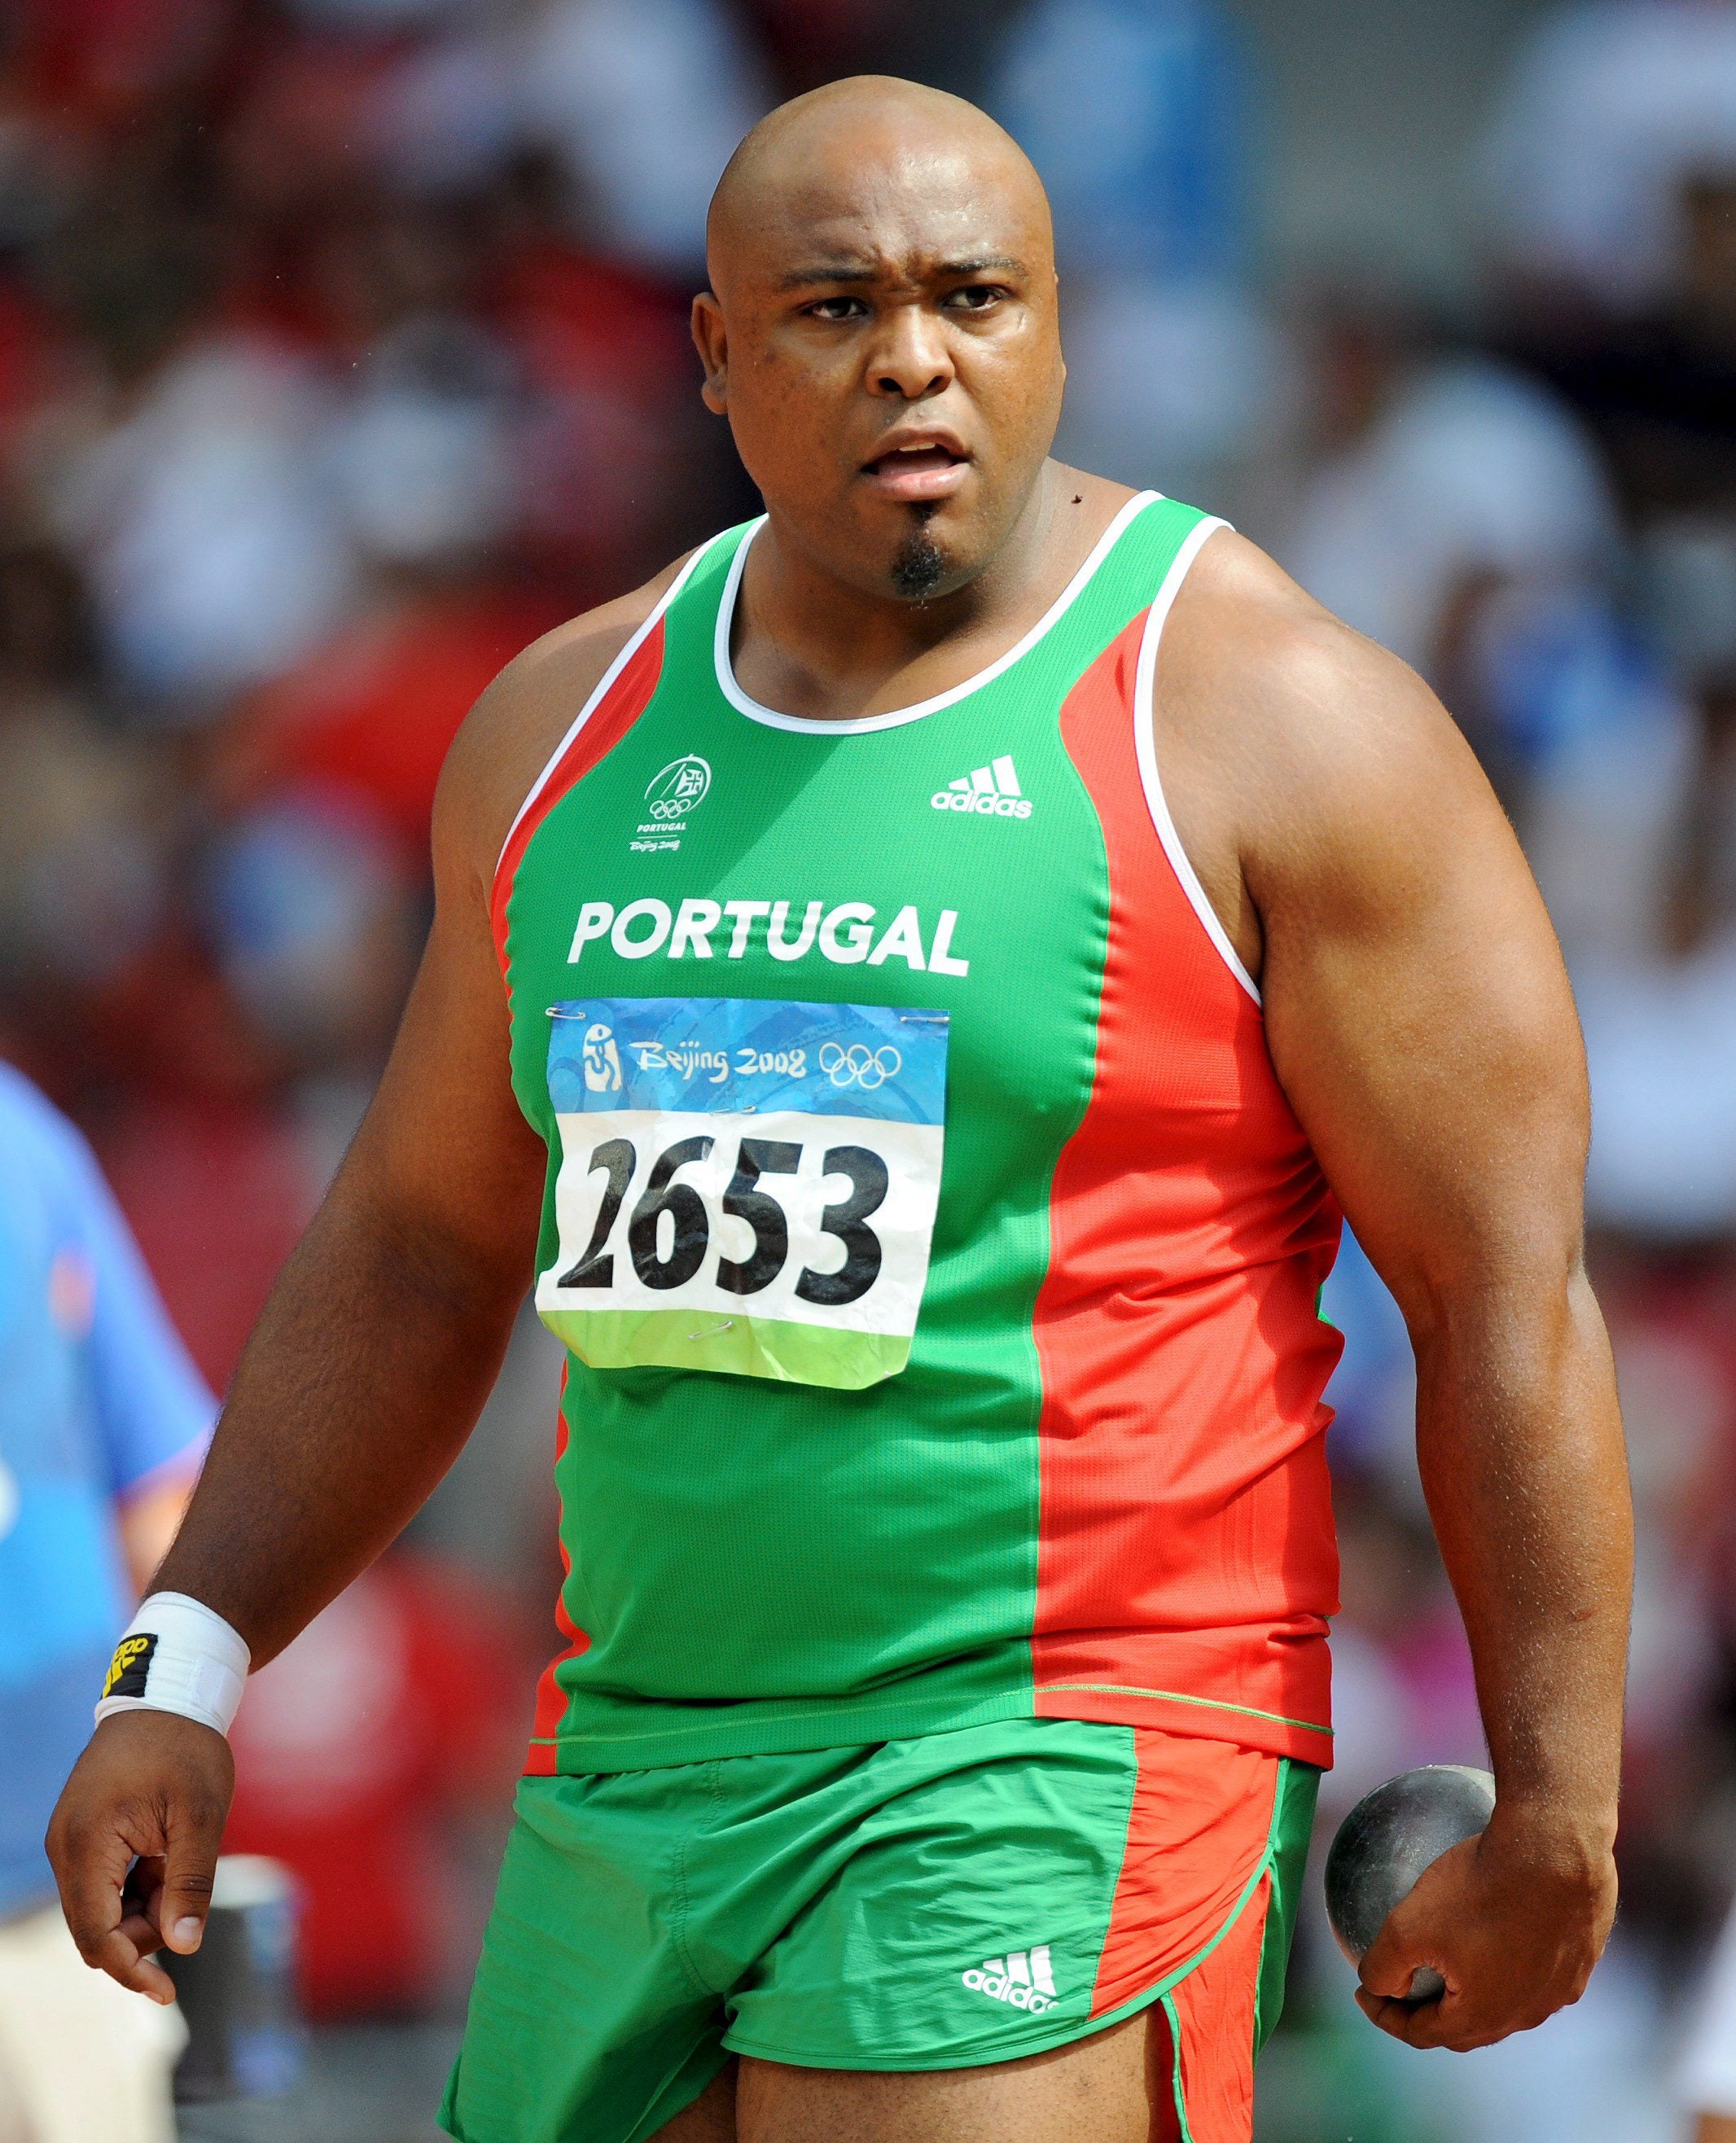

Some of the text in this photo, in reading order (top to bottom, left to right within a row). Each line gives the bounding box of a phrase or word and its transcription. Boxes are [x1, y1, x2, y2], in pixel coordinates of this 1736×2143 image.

[930, 789, 1033, 819] adidas
[636, 822, 687, 833] PORTUGAL
[567, 897, 970, 978] PORTUGAL
[629, 1040, 808, 1083] Beijing 2008
[557, 1136, 889, 1306] 2653
